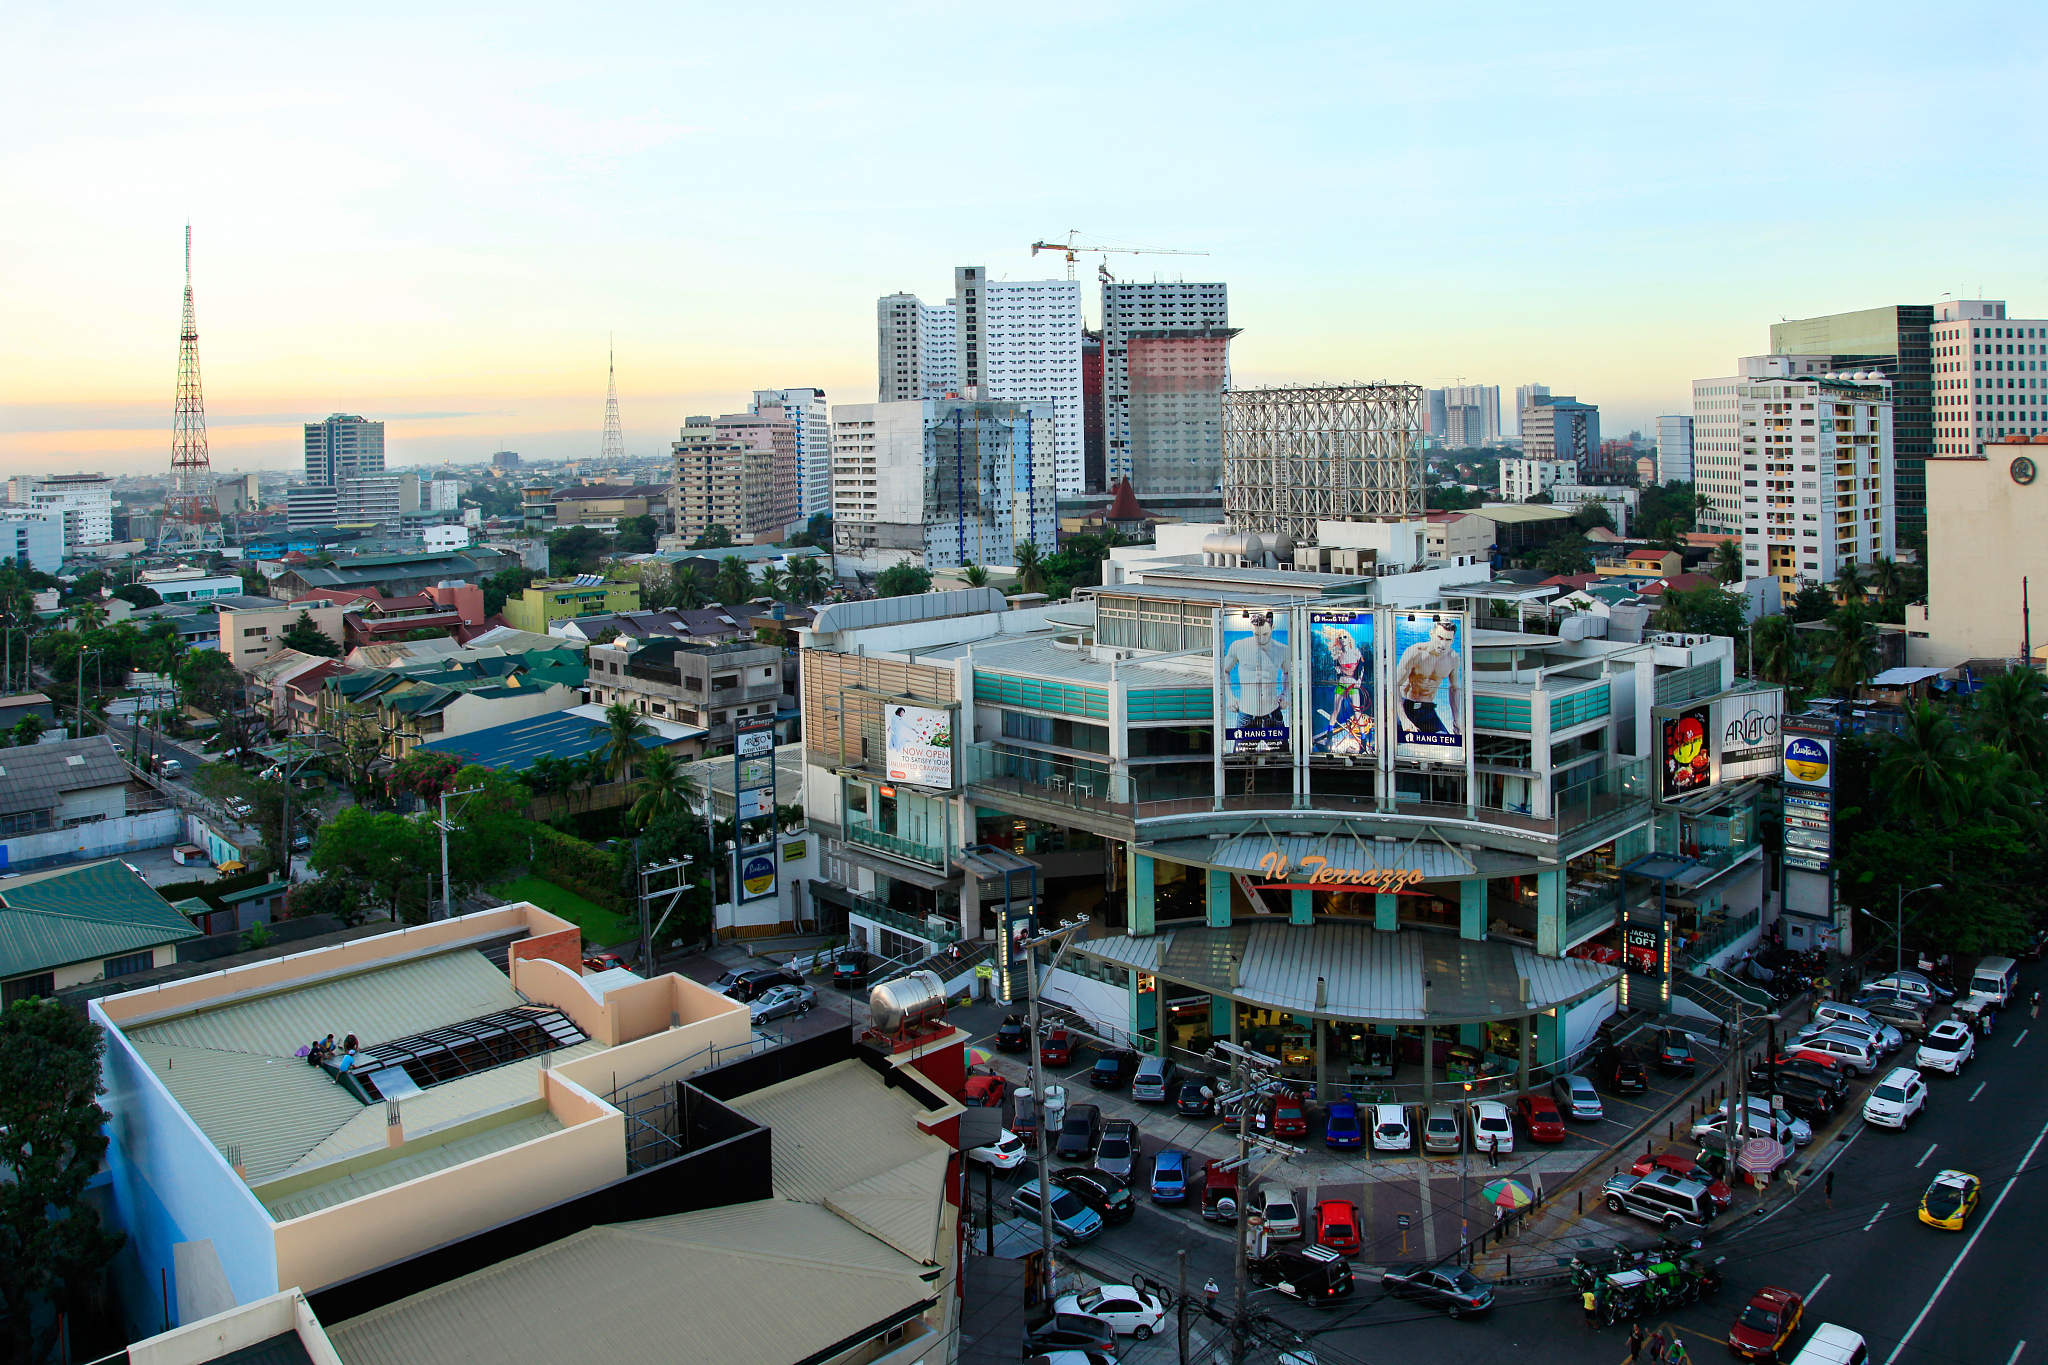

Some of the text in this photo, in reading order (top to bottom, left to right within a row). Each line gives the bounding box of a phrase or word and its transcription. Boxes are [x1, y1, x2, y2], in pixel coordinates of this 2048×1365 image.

[748, 718, 774, 727] Terrazzo
[1784, 717, 1829, 732] Il Terrazzo
[1244, 729, 1283, 738] HANG TEN
[1724, 715, 1778, 742] ARIATO
[1416, 734, 1455, 744] HANG TEN
[902, 747, 949, 759] NOW OPEN
[911, 757, 931, 765] SATISFY
[888, 760, 950, 774] UNLIMITED CRAVINGS
[1790, 798, 1830, 808] KRYOLAN
[1259, 852, 1425, 894] Il Terrazzo
[1629, 929, 1657, 940] JACK'S
[1629, 935, 1656, 948] LOFT
